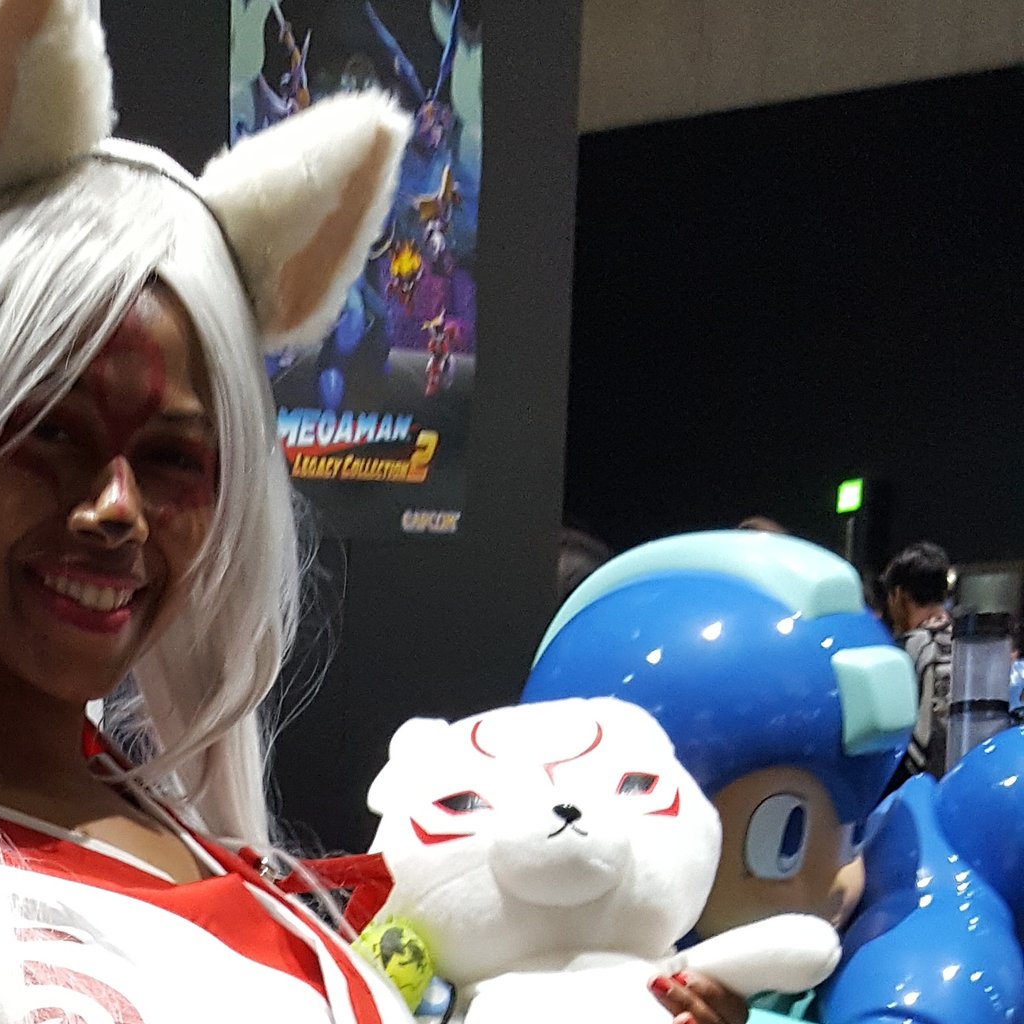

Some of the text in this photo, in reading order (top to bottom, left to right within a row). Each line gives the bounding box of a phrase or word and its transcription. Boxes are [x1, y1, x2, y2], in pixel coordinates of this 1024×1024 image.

[292, 429, 439, 483] LEGACY COLLECTION 2
